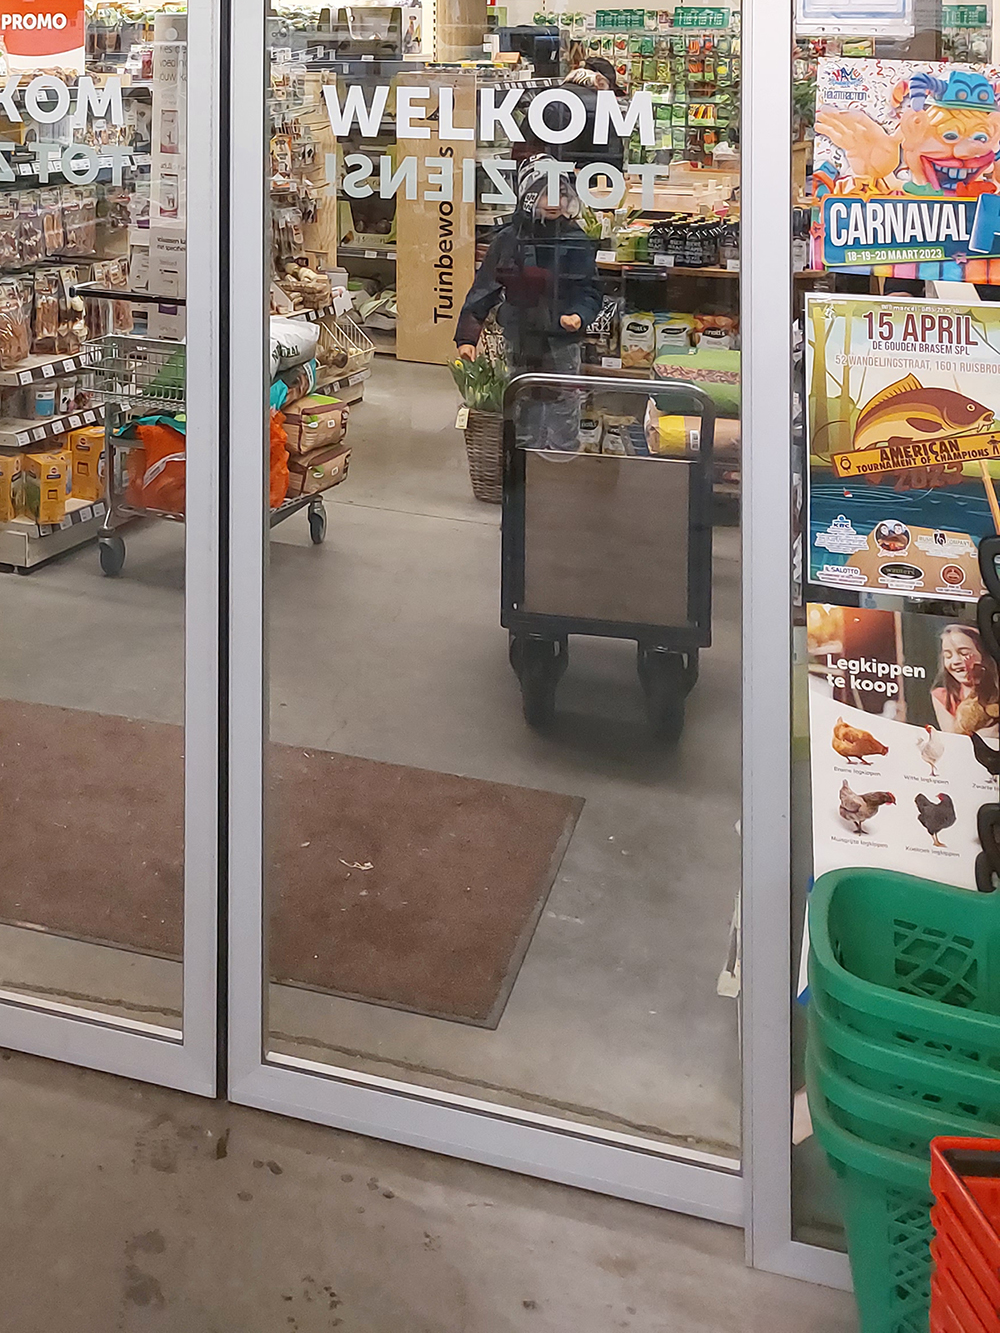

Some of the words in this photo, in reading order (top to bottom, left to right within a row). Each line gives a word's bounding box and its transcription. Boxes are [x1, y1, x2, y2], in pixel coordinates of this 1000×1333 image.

[1, 13, 67, 30] PROMO
[322, 85, 656, 146] WELKOM
[434, 146, 455, 324] Tuinbewos
[829, 202, 970, 247] CARNAVAL
[847, 250, 887, 262] 18-19-20
[888, 249, 919, 261] MAART
[920, 248, 942, 259] 2023
[863, 312, 894, 341] 15
[903, 313, 978, 346] APRIL
[873, 340, 883, 350] DE
[884, 341, 916, 352] GOUDEN
[919, 342, 952, 355] BRASEM
[954, 345, 970, 356] SPL
[835, 355, 848, 365] 52
[849, 356, 932, 371] WANDELINGSTRAAT,
[856, 458, 918, 473] TOURNAMENT
[921, 455, 932, 465] OF
[934, 448, 990, 463] CHAMPIONS
[879, 439, 960, 463] AMERICAN
[830, 567, 859, 575] SALOTTO
[826, 653, 927, 679] Legkippen
[825, 672, 847, 689] te
[850, 674, 900, 698] koop
